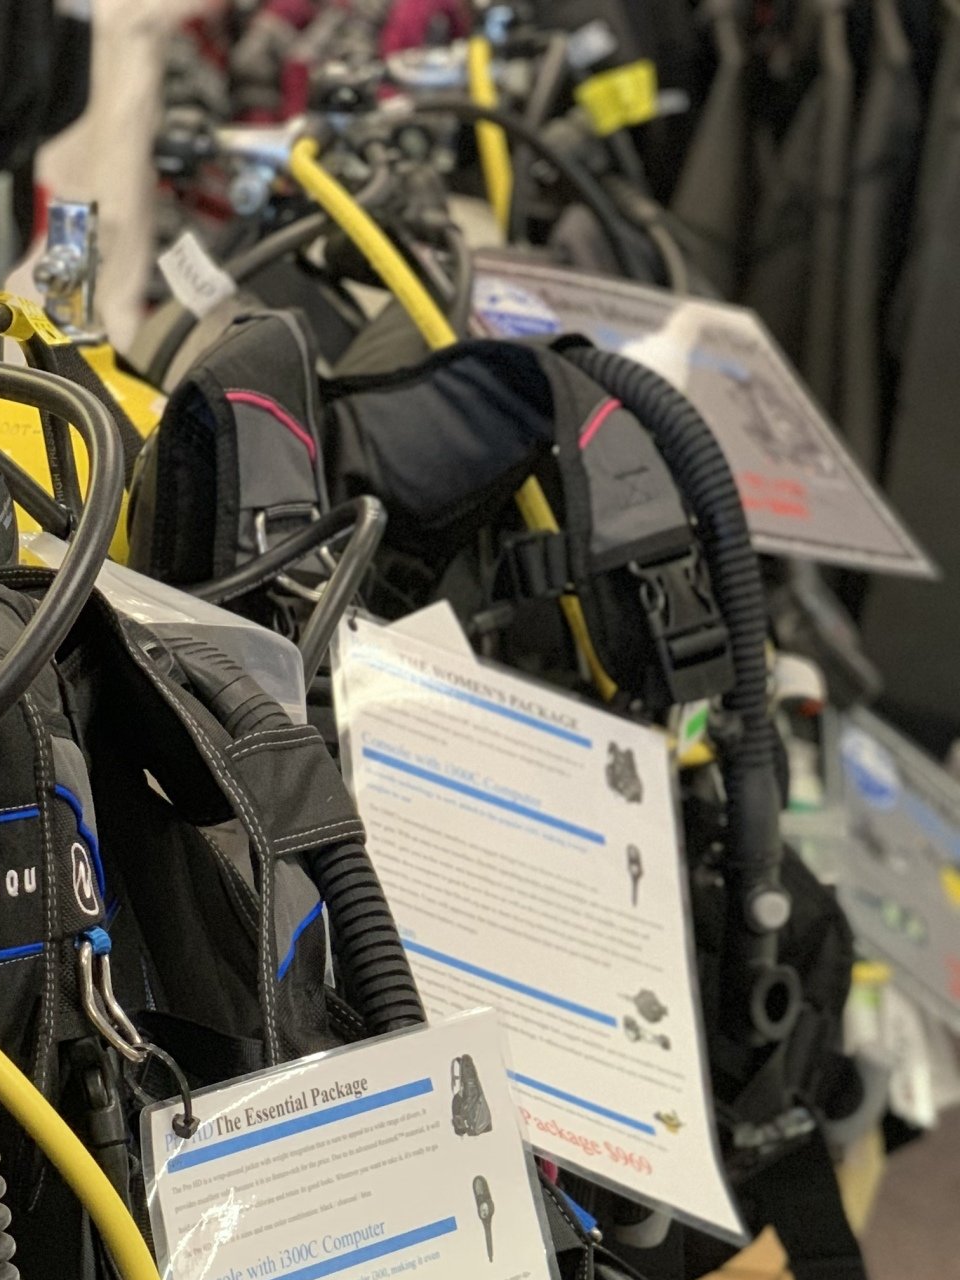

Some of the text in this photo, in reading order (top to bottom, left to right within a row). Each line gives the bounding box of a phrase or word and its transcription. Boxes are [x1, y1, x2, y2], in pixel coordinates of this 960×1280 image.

[509, 692, 579, 731] PACKAGE
[215, 1114, 241, 1136] The
[243, 1092, 308, 1128] Essential
[311, 1076, 369, 1107] Package
[518, 1105, 603, 1157] Package
[280, 1239, 319, 1269] i300C
[321, 1220, 386, 1255] Computer
